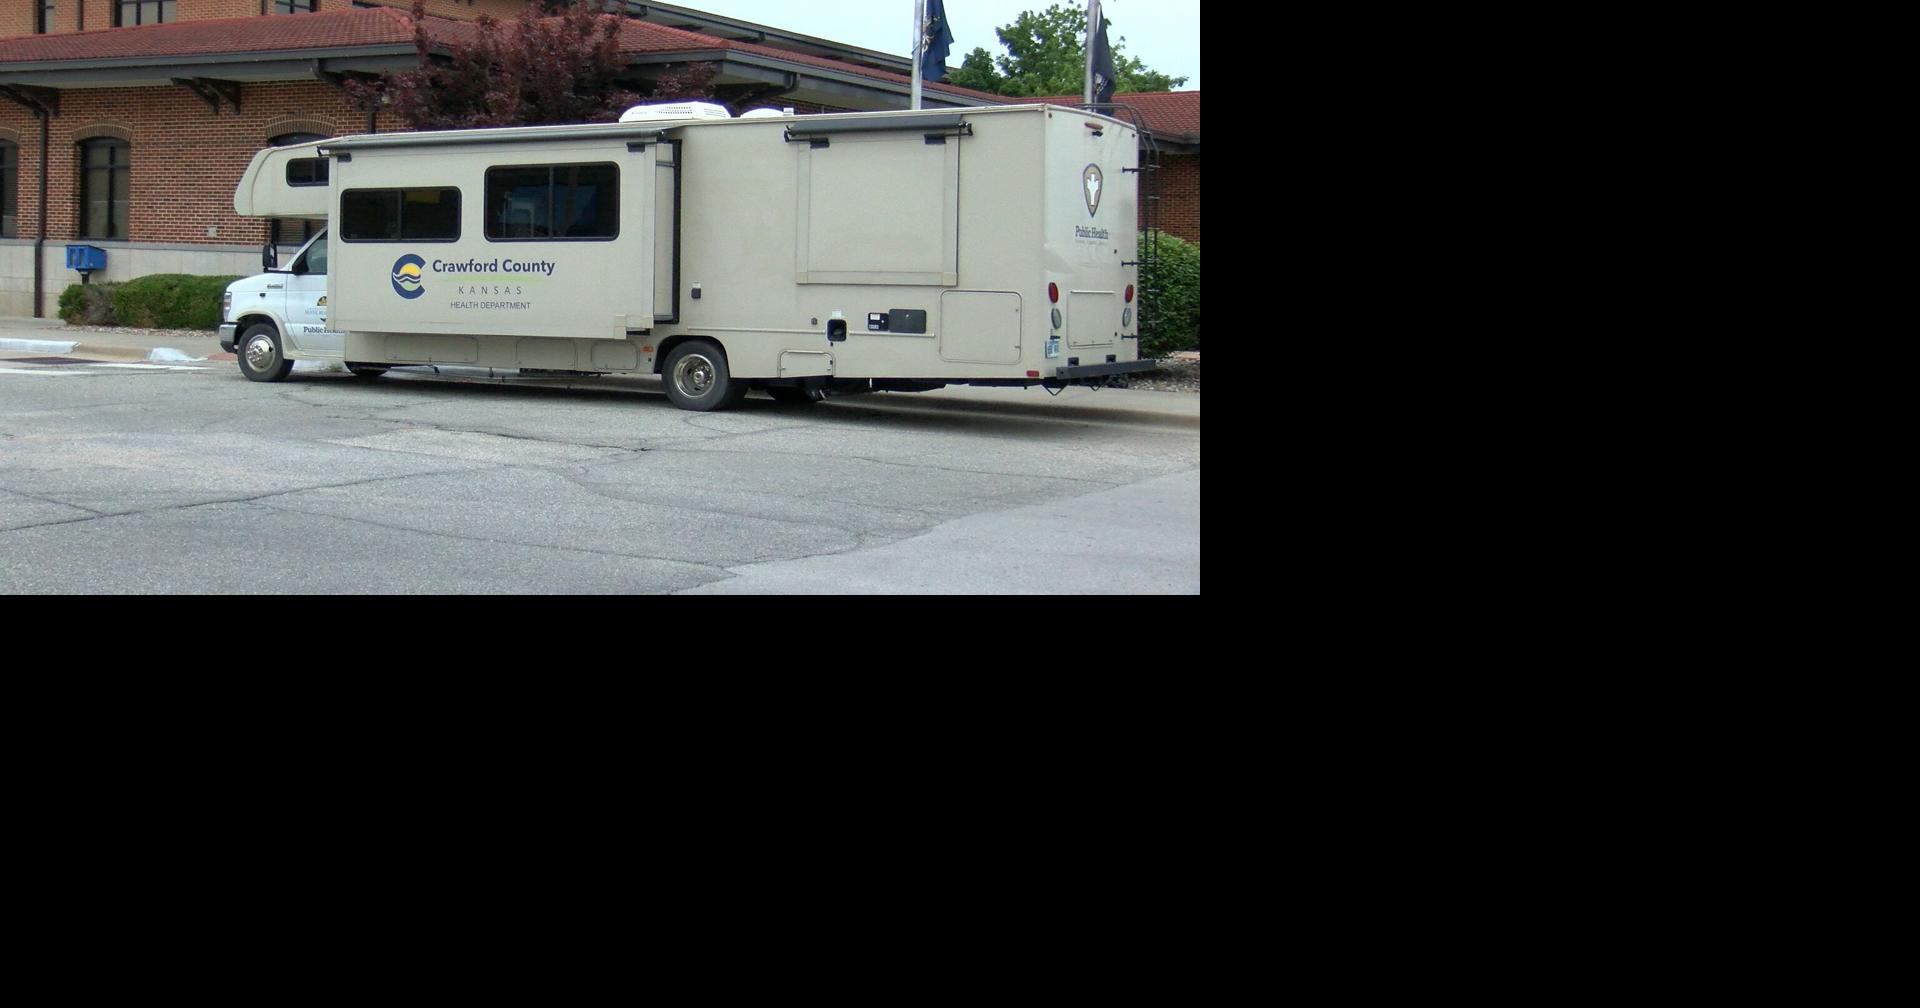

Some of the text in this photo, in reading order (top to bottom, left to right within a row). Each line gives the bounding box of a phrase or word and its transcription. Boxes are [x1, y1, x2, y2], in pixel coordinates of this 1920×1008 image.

[432, 258, 555, 276] Crawford County
[458, 285, 522, 295] KANSAS
[450, 301, 531, 310] HEALTH DEPARTMENT
[303, 326, 323, 334] Public
